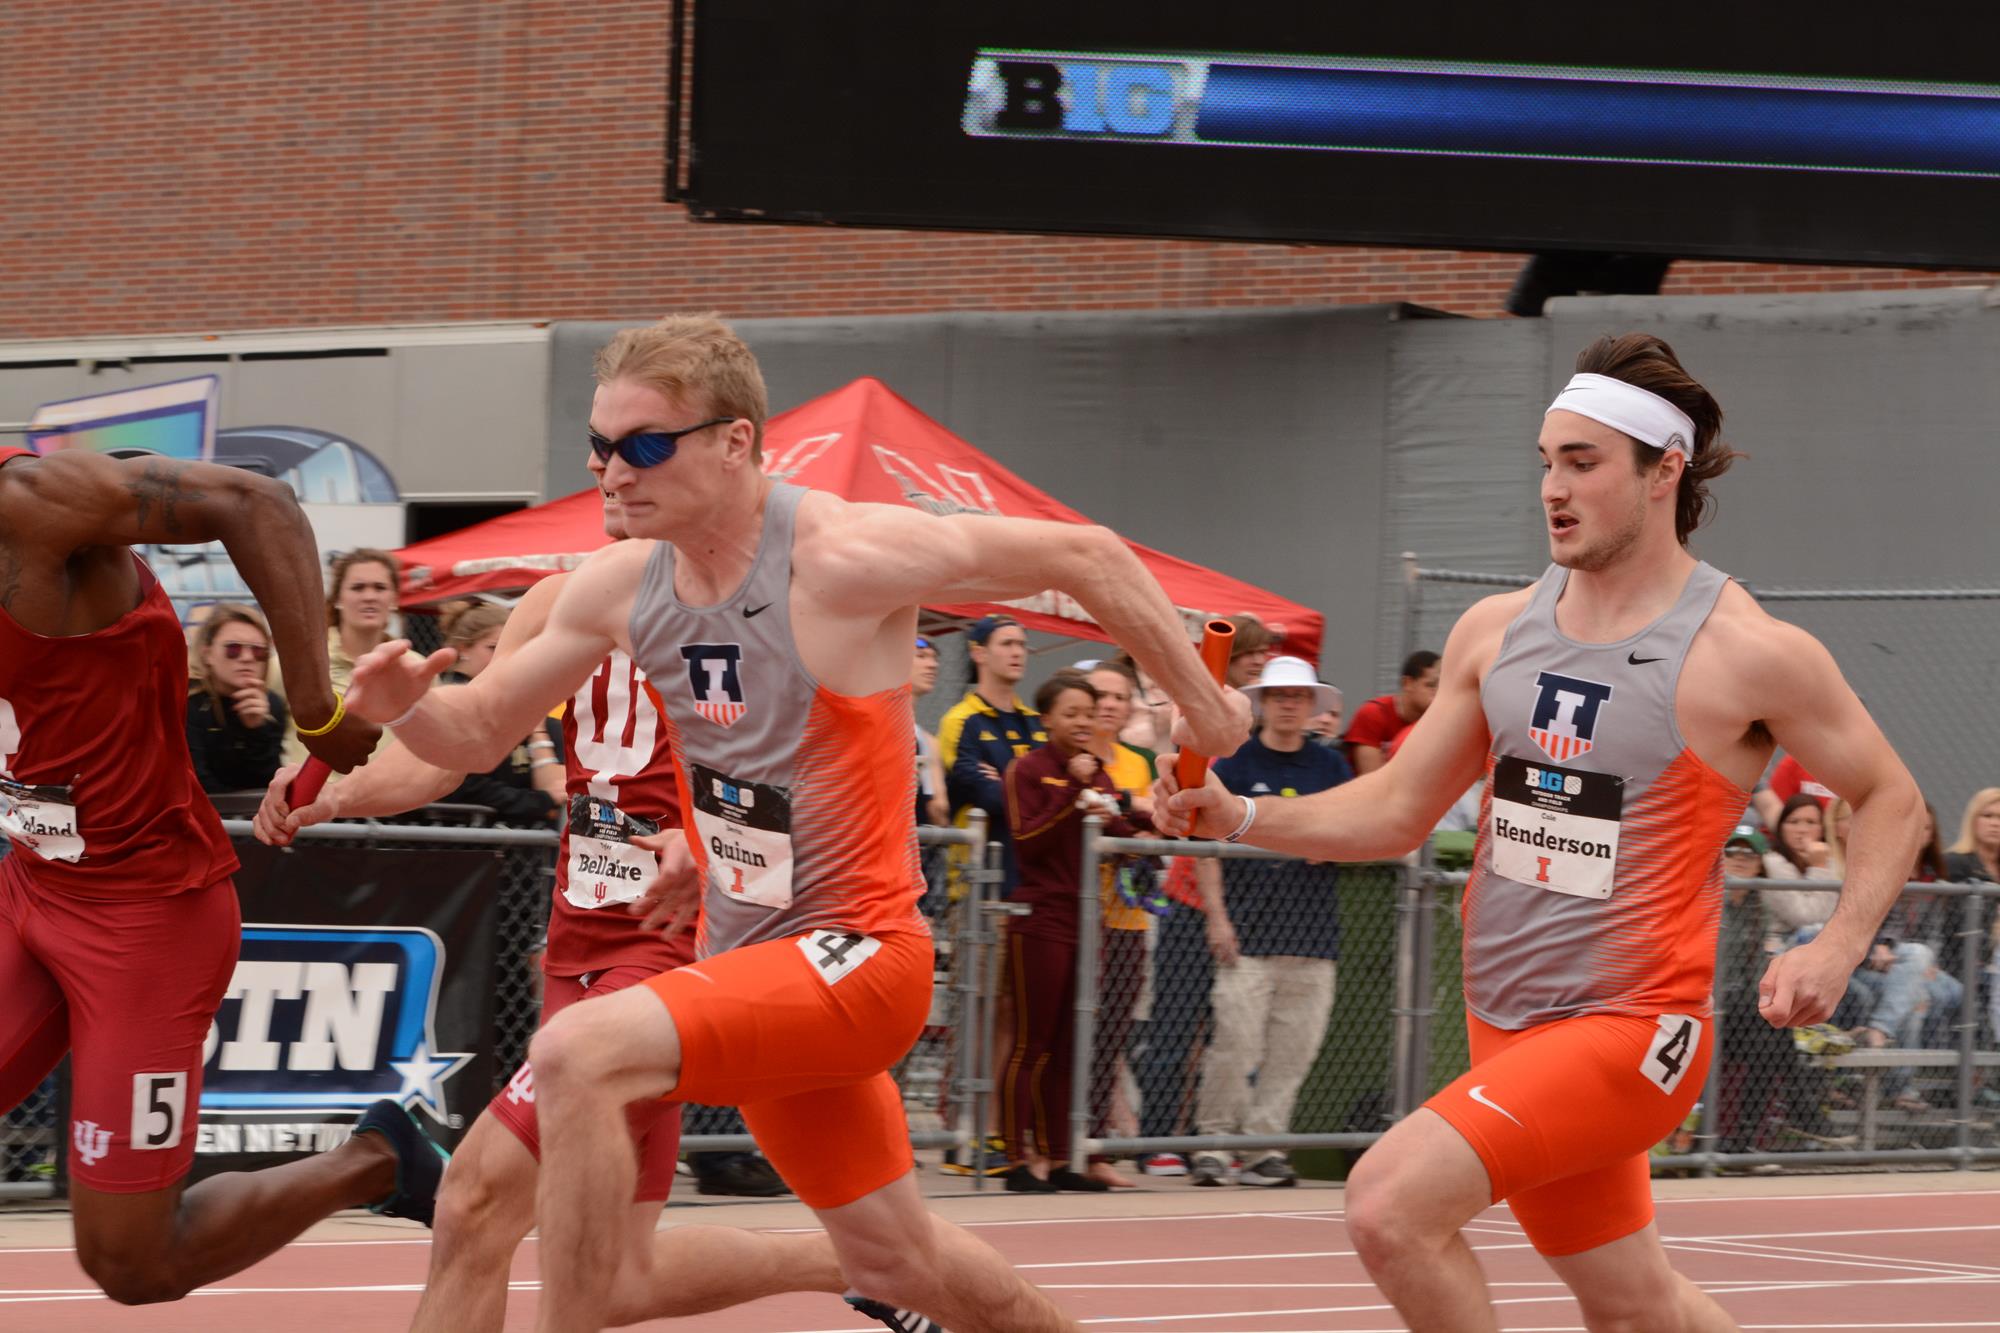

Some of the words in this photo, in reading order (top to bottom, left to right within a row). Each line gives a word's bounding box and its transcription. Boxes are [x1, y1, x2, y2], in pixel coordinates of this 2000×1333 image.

[712, 836, 767, 868] Quinn
[1496, 817, 1611, 859] Henderson
[578, 854, 642, 881] Bellaire
[817, 933, 864, 969] 4
[1656, 1020, 1692, 1085] 4
[147, 1077, 176, 1145] 5
[195, 1123, 242, 1153] EN
